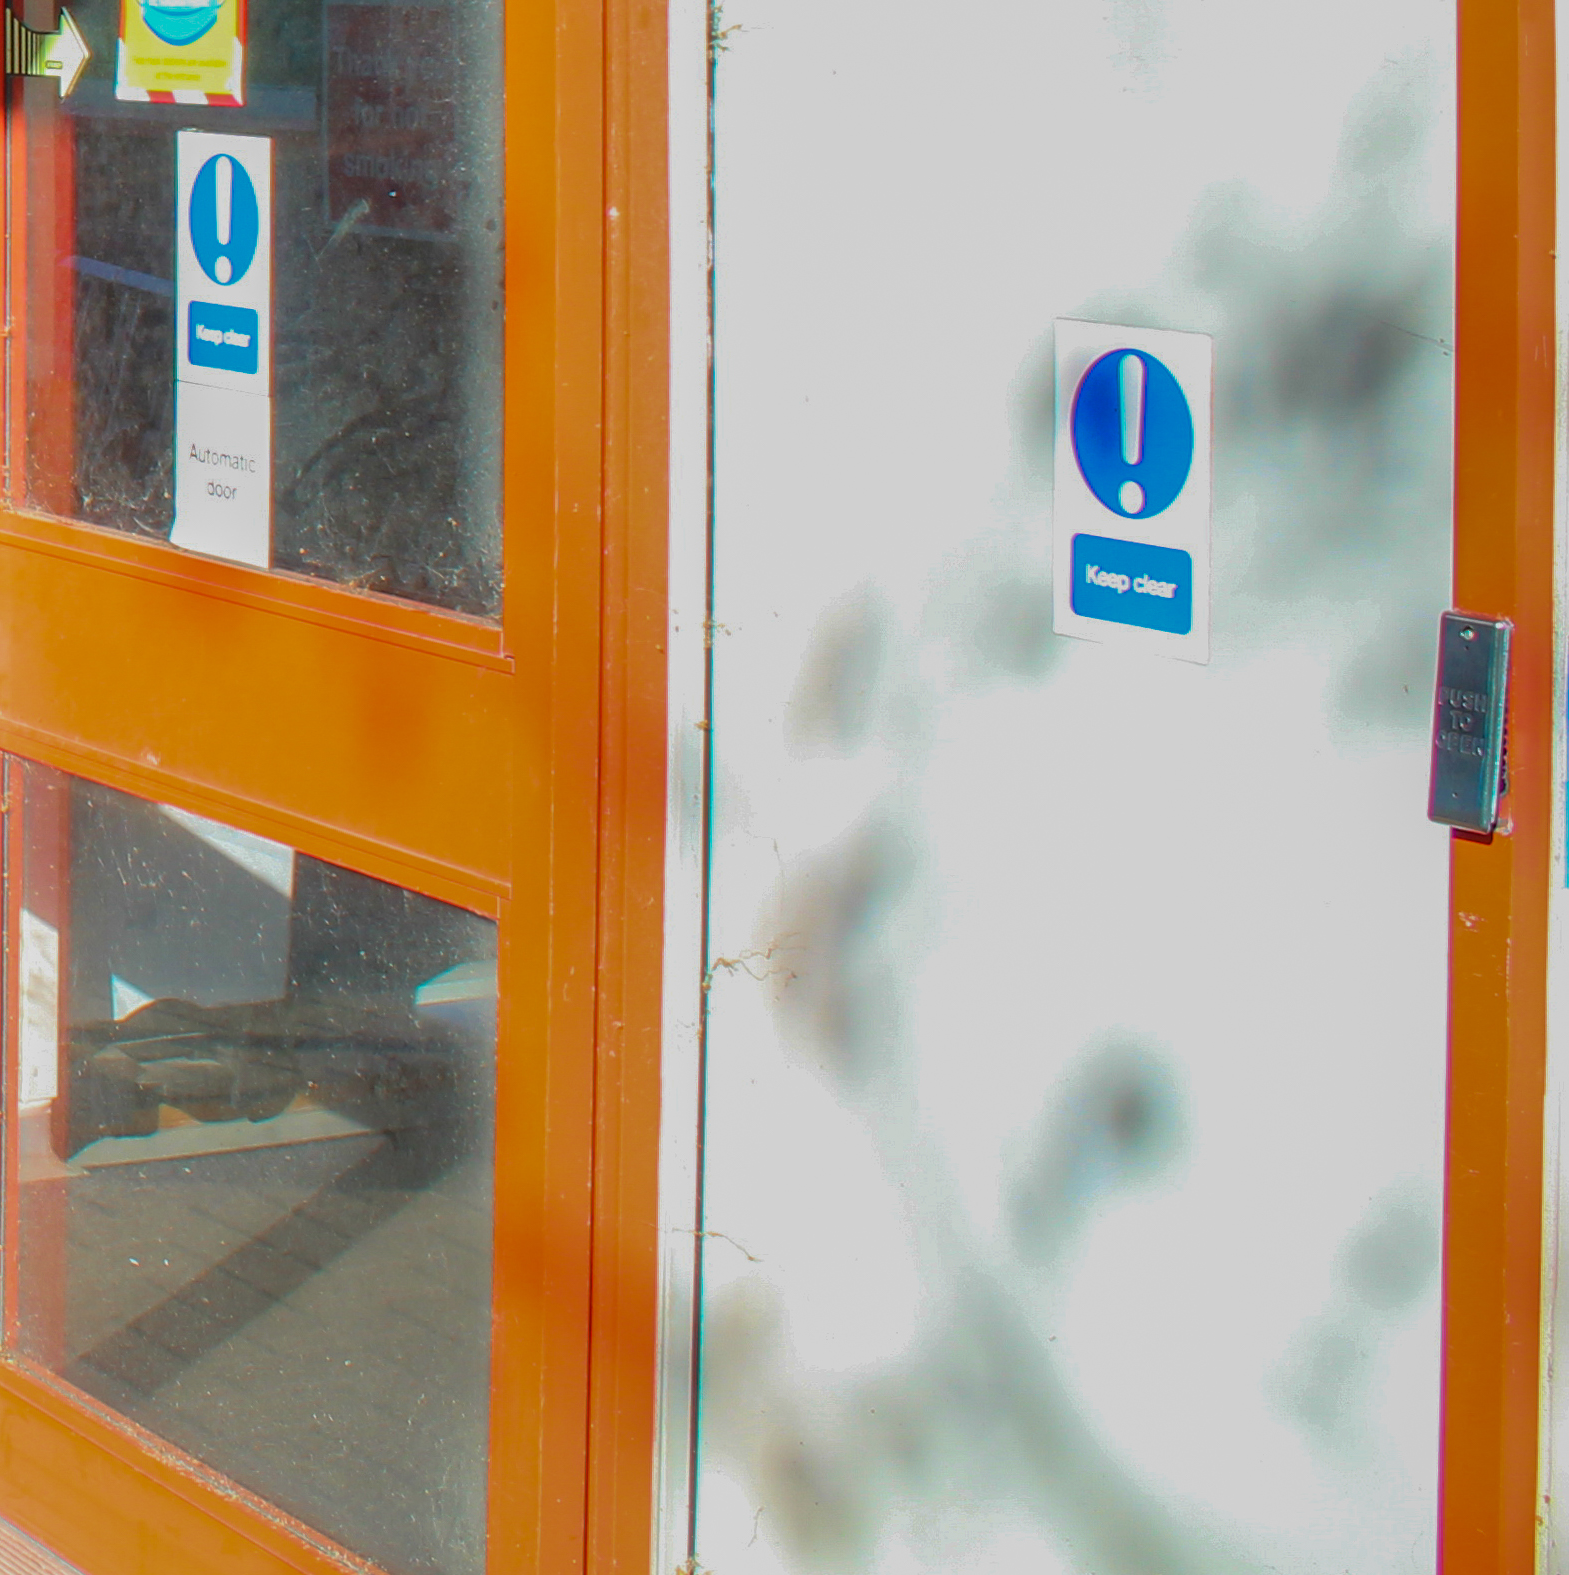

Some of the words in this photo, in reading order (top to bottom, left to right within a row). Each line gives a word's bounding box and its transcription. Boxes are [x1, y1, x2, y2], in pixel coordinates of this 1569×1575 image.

[196, 323, 223, 346] Keep
[223, 328, 251, 348] clear
[189, 443, 257, 475] Automatic
[207, 478, 239, 502] door
[1085, 563, 1131, 594] Keep
[1133, 573, 1178, 600] clear
[1438, 686, 1488, 714] PUSH
[1449, 709, 1472, 730] TO
[1435, 730, 1486, 758] OPEN
